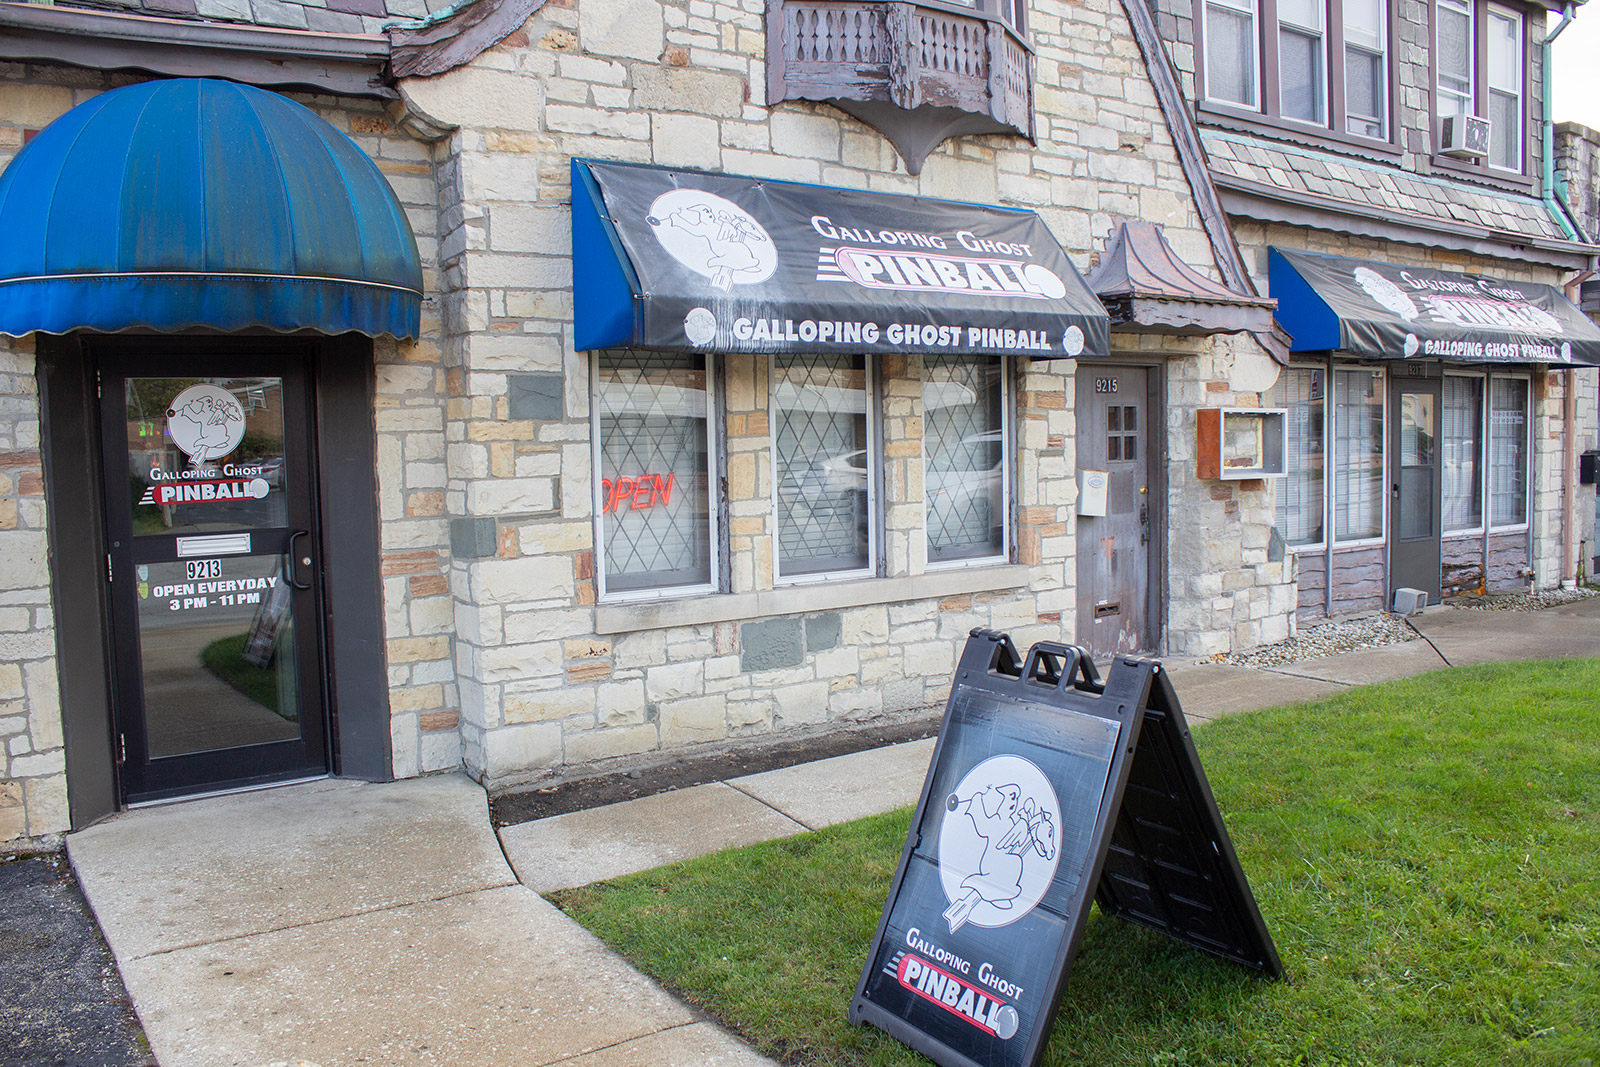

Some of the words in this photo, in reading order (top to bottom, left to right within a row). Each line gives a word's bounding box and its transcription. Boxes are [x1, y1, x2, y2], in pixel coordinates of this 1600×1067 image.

[810, 215, 947, 250] GALLOPING
[955, 230, 1033, 257] GHOST
[848, 252, 1045, 295] PINBALL
[732, 317, 880, 344] GALLOPING
[886, 322, 962, 347] GHOST
[967, 327, 1052, 351] PINBALL
[1424, 339, 1483, 357] GALLOPING
[1485, 342, 1519, 357] GHOST
[1520, 344, 1559, 359] PINBALL
[1095, 378, 1118, 393] 9215
[150, 467, 216, 481] GALLOPING
[223, 463, 264, 477] GHOST
[160, 481, 256, 503] PINBALL
[187, 560, 221, 579] 9213
[153, 582, 196, 598] OPEN
[197, 576, 278, 594] EVERYDAY
[169, 599, 181, 611] 3
[183, 596, 208, 609] PM
[219, 594, 234, 607] 11
[236, 592, 261, 605] PM
[905, 927, 971, 975] GALLOPING
[977, 962, 1024, 1001] GHOST
[902, 957, 1000, 1034] PINBALL
